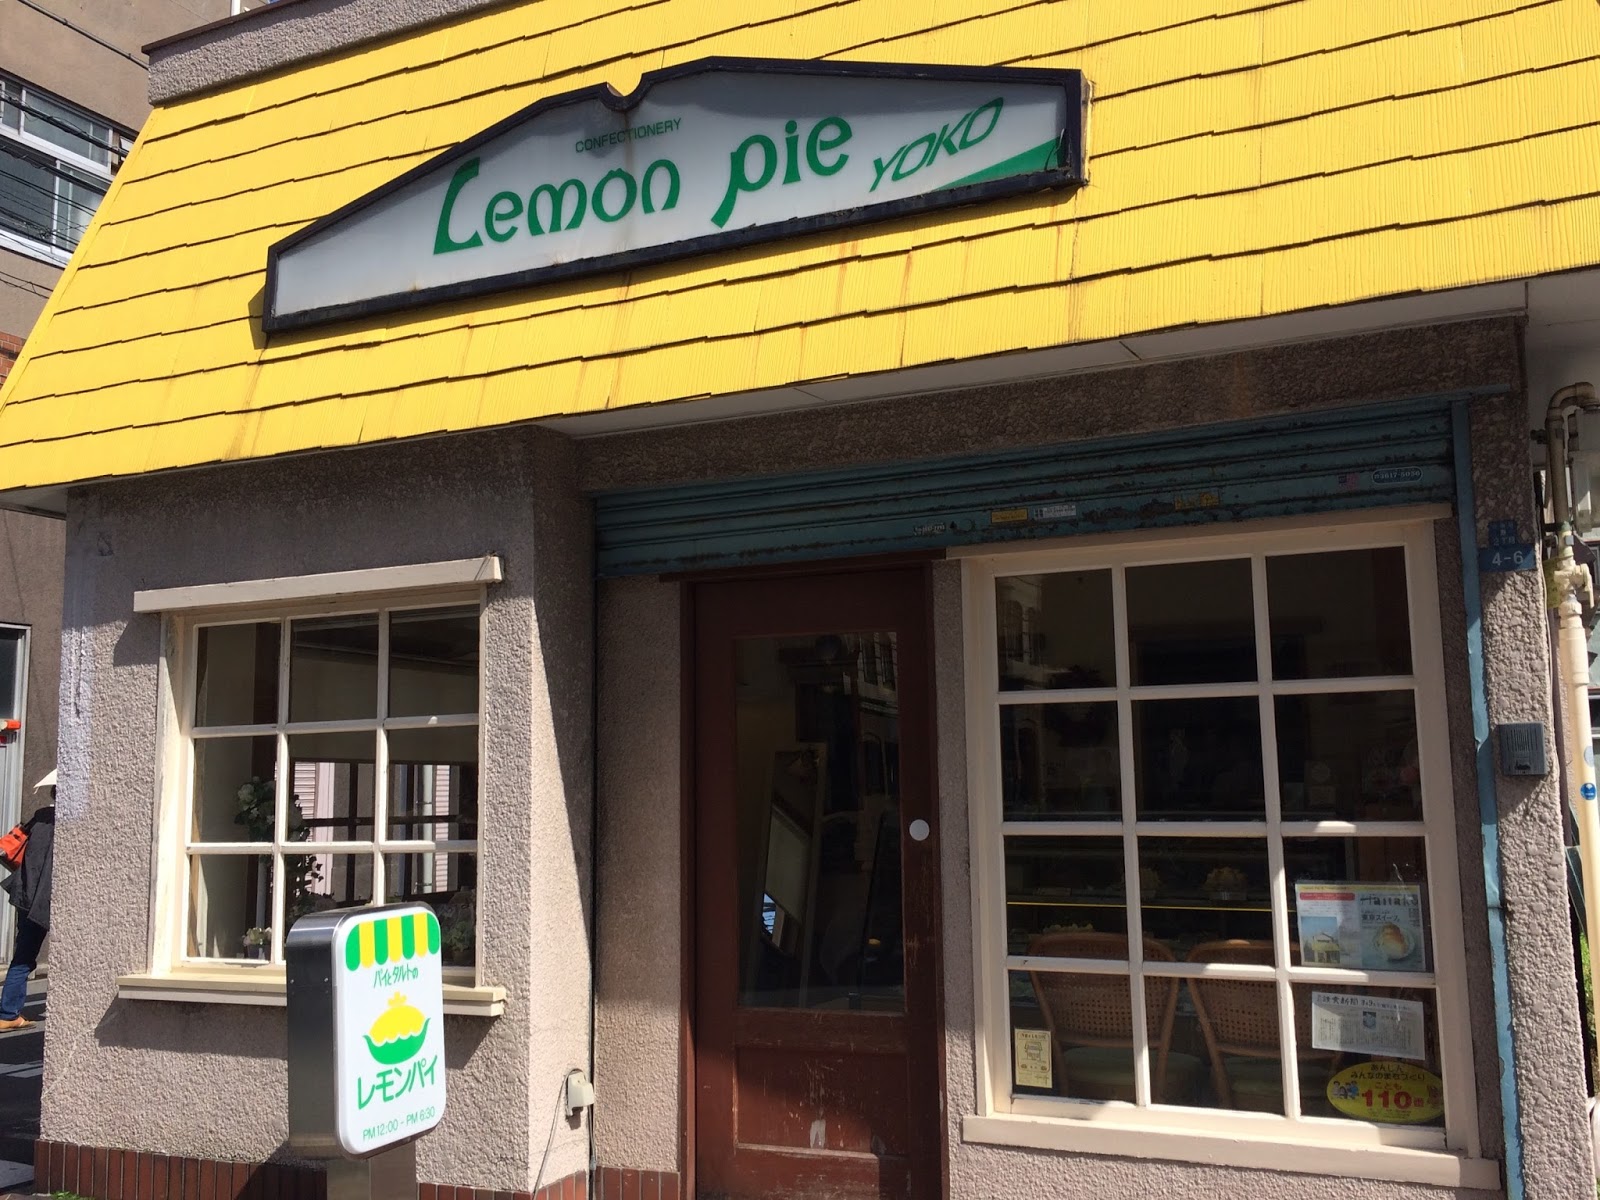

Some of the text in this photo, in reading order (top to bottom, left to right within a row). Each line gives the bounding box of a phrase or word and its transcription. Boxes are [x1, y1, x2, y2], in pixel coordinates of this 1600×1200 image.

[575, 117, 682, 153] CONFECTIONERY
[869, 97, 1004, 193] YOKO
[433, 116, 853, 255] Lemon pie
[1492, 550, 1523, 566] 4-6
[373, 963, 418, 988] パイとタルトの
[357, 1055, 438, 1110] レモンパイ
